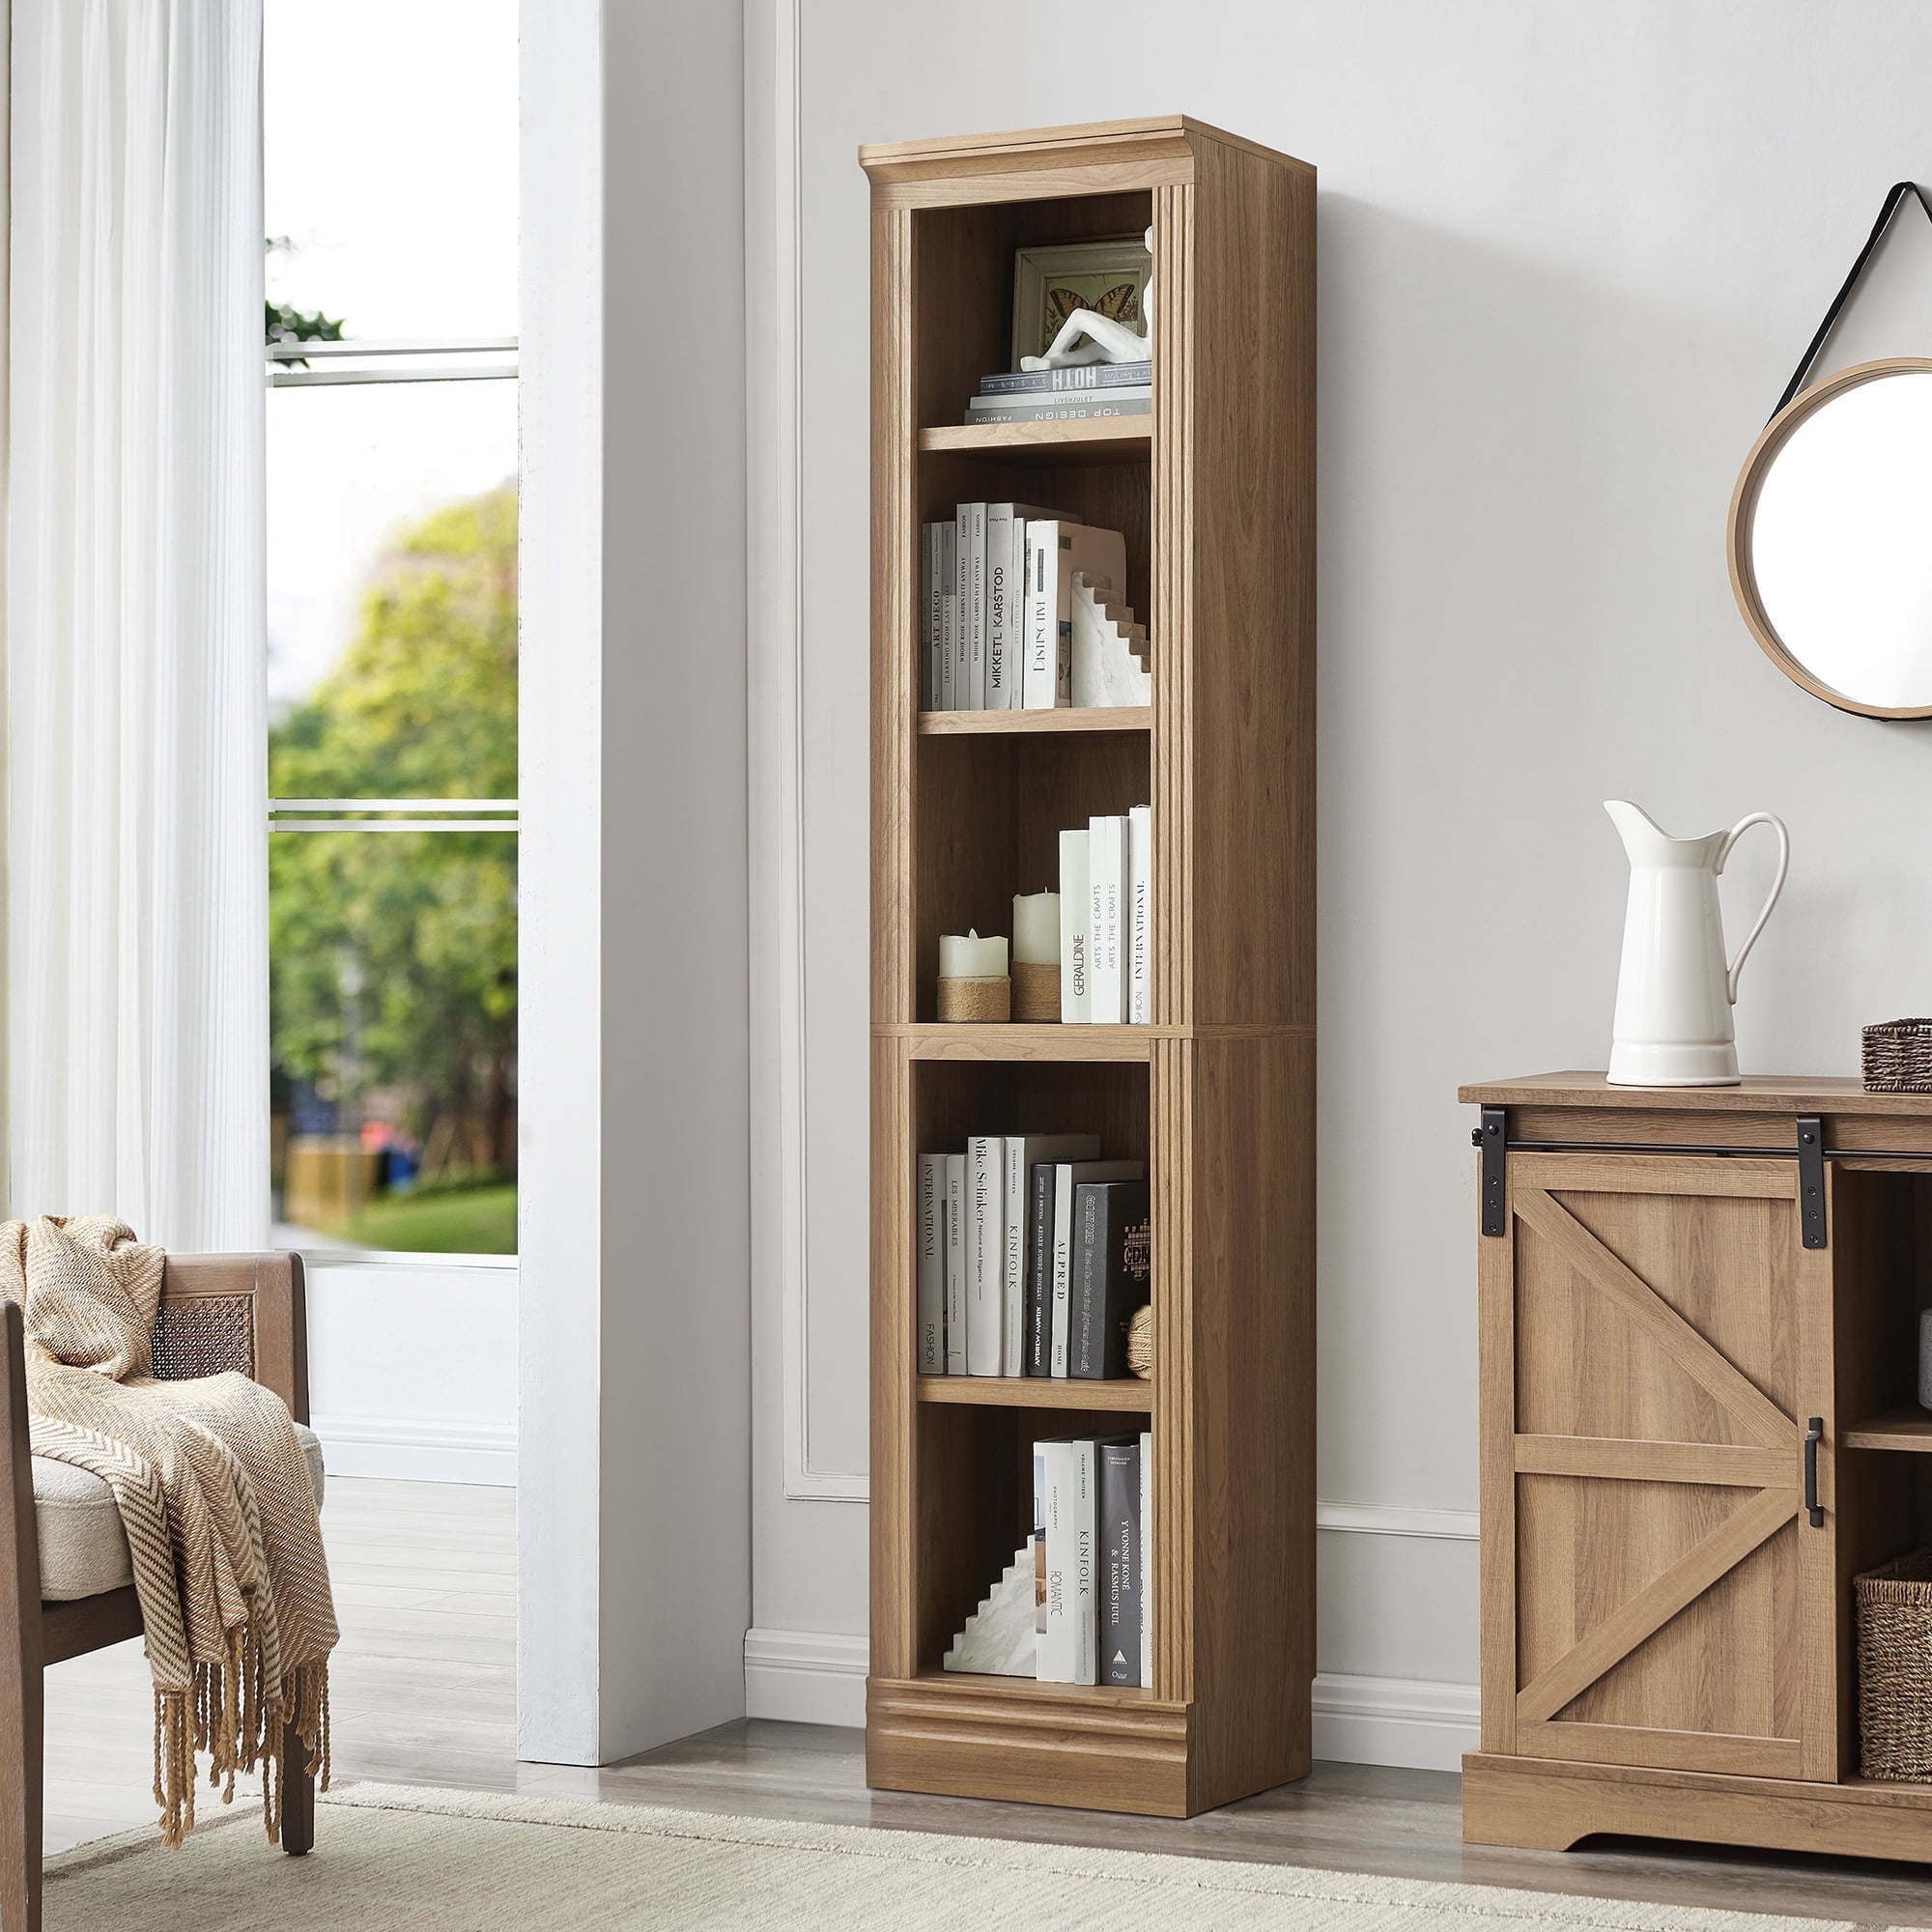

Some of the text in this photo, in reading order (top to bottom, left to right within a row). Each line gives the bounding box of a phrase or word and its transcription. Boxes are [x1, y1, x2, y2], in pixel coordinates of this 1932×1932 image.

[1052, 366, 1096, 390] HOTH
[1035, 410, 1087, 420] DESIGN
[1093, 408, 1121, 417] TOP
[991, 567, 1004, 689] MIKKETL KARSTOD
[1135, 880, 1145, 980] INTERNATIONAL
[1072, 934, 1085, 996] GERALDINE
[976, 1139, 987, 1168] Mike
[976, 1172, 987, 1223] Selinker
[924, 1163, 934, 1365] INTERNATIONAL FASHION
[1009, 1225, 1018, 1289] KINFOLK
[1057, 1240, 1065, 1300] ALPRED
[1079, 1531, 1090, 1596] KINFOLK
[1121, 1528, 1129, 1562] VONNE
[1050, 1571, 1063, 1616] ROMANTIC
[1122, 1564, 1130, 1590] KONÉ
[1110, 1603, 1119, 1626] JUUL
